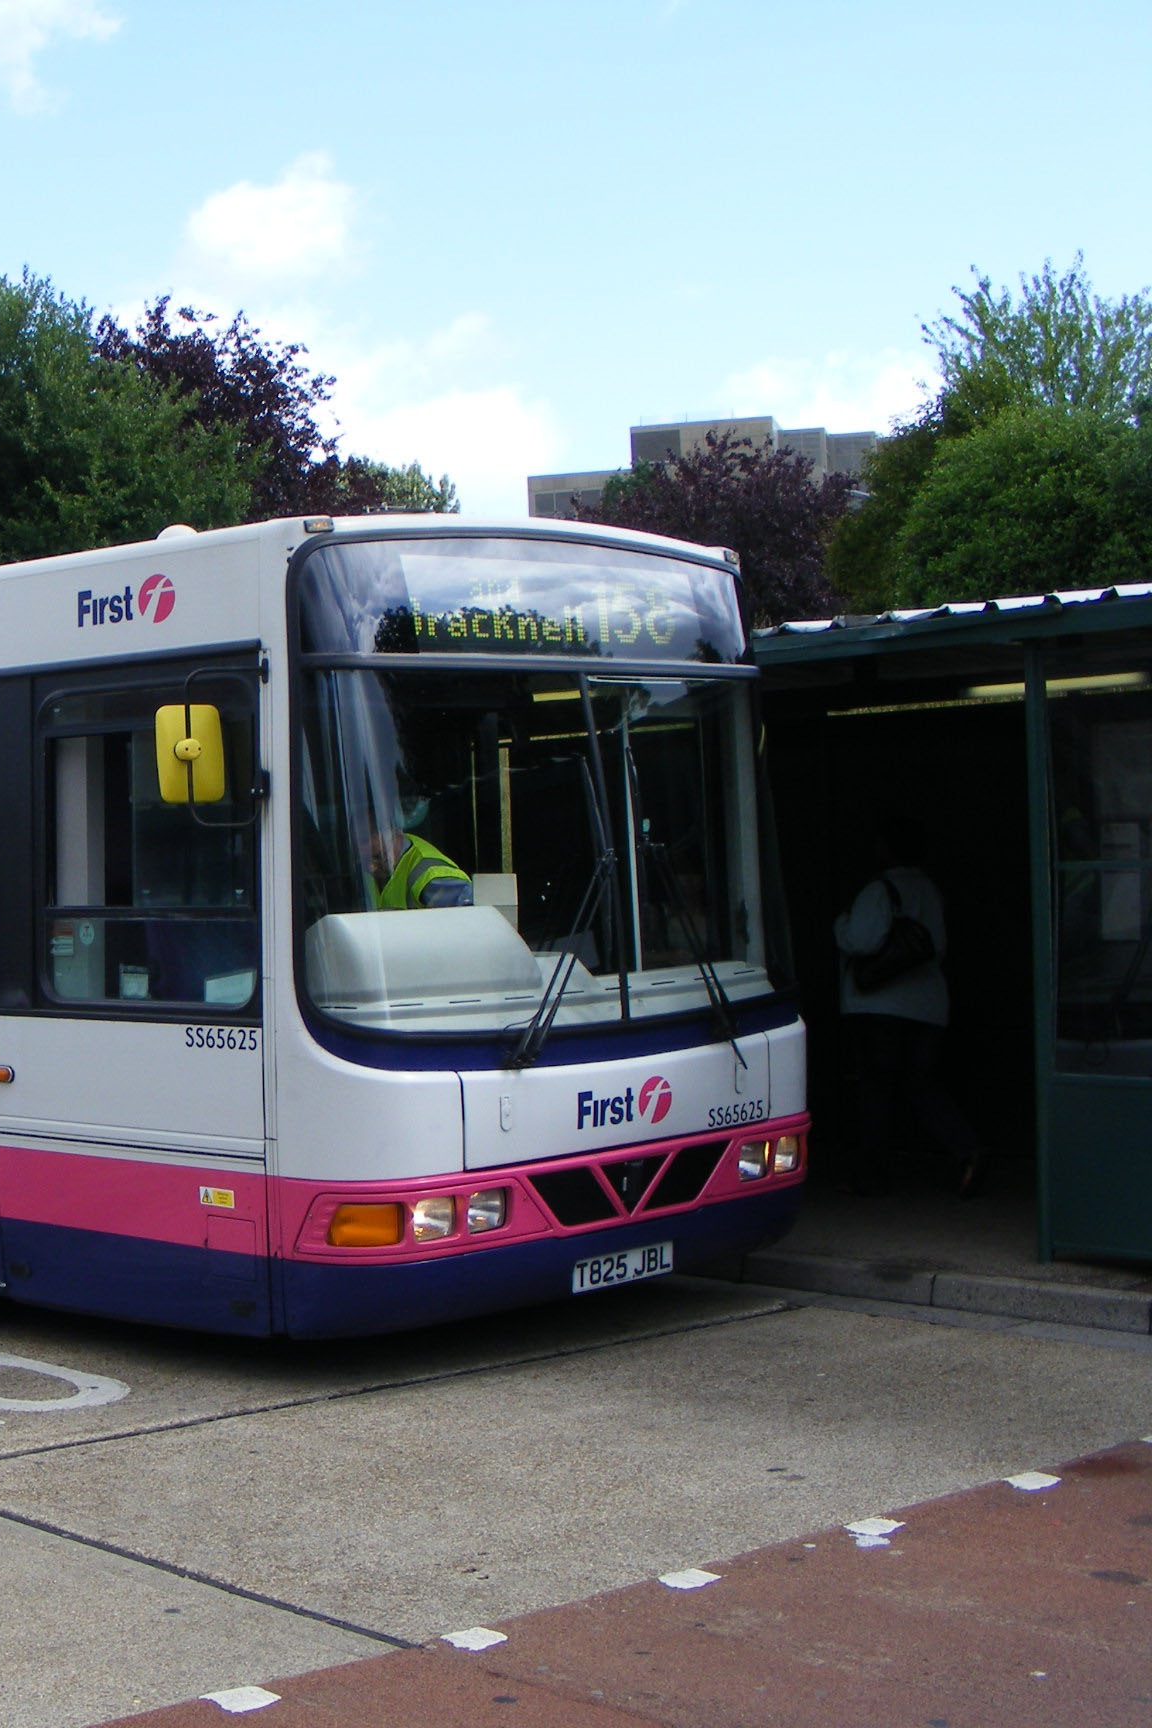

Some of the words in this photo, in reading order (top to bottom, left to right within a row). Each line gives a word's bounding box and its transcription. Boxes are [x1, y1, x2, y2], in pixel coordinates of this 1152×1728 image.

[77, 585, 134, 628] First
[185, 1026, 258, 1051] SS65625
[577, 1087, 634, 1130] First
[708, 1100, 764, 1128] SS65625
[576, 1253, 628, 1288] T825
[633, 1245, 671, 1278] JBL
